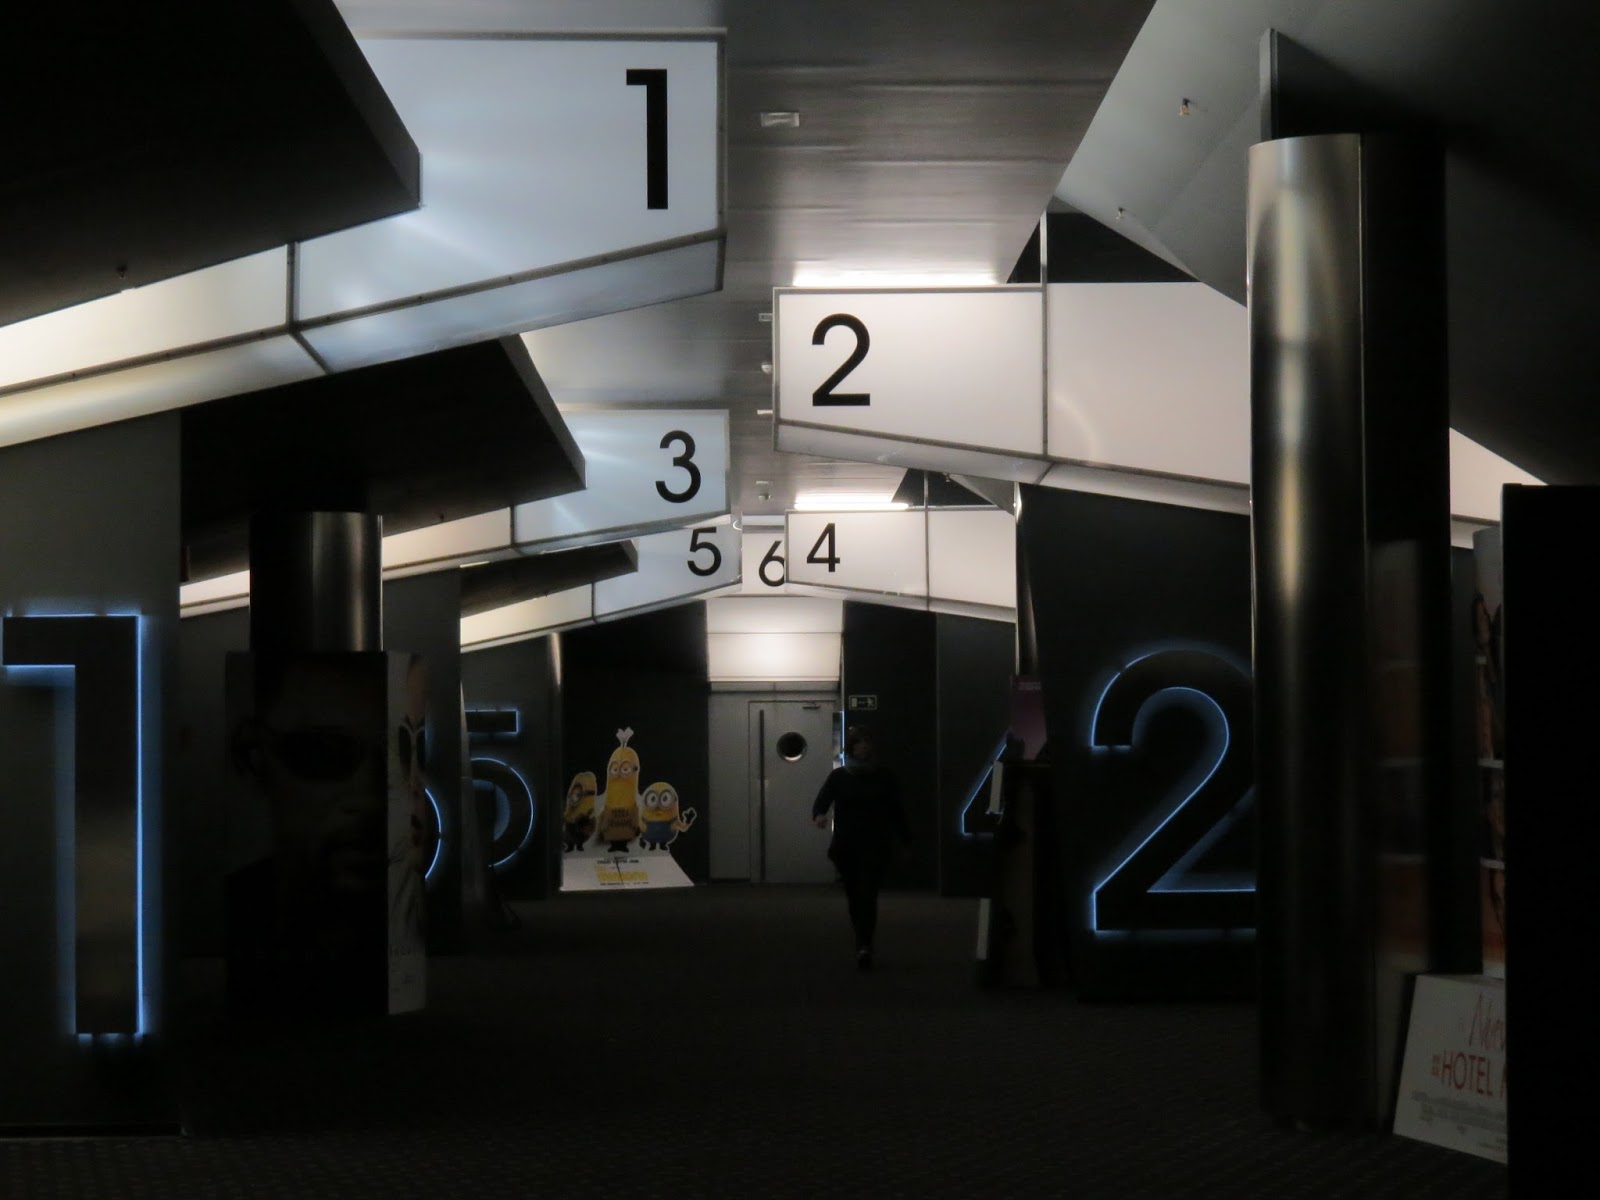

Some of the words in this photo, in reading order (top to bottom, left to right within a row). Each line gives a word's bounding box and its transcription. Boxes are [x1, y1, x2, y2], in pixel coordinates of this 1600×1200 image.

[626, 69, 668, 209] 1
[812, 313, 870, 406] 2
[655, 430, 701, 503] 3
[687, 526, 722, 576] 5
[758, 540, 785, 587] 6
[806, 523, 841, 573] 4
[2, 614, 143, 1036] 1
[1090, 648, 1256, 935] 2
[1440, 1050, 1493, 1097] HOTEL
